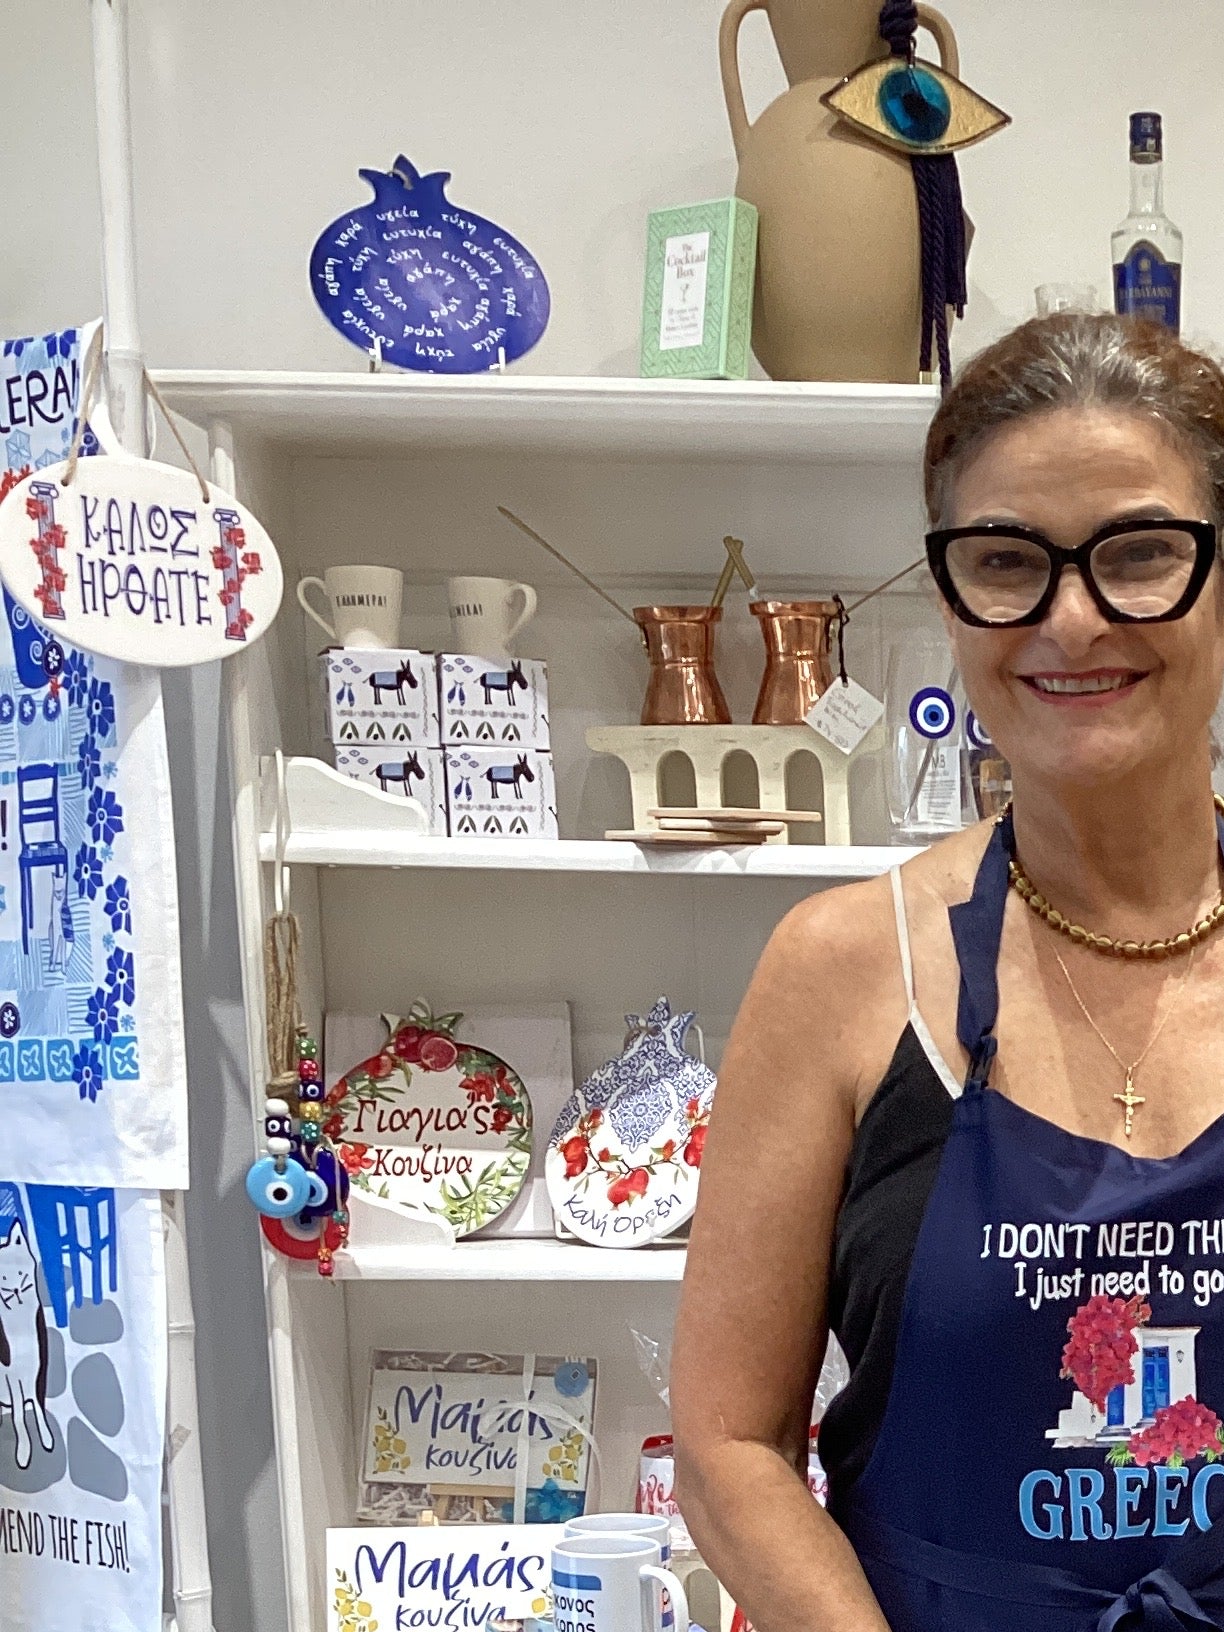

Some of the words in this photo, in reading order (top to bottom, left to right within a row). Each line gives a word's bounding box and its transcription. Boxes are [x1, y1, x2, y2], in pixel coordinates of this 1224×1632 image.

[0, 360, 77, 433] ERA!
[372, 1143, 473, 1183] Κουζίνα
[980, 1223, 993, 1258] I
[998, 1222, 1091, 1259] DON'T
[1097, 1221, 1175, 1258] NEED
[1014, 1261, 1027, 1298] I
[1030, 1266, 1085, 1310] just
[1091, 1259, 1150, 1297] need
[1158, 1264, 1184, 1295] to
[1193, 1268, 1224, 1307] go
[48, 1514, 80, 1564] THE
[85, 1519, 130, 1574] FISH!
[355, 1541, 545, 1601] Μαμάς
